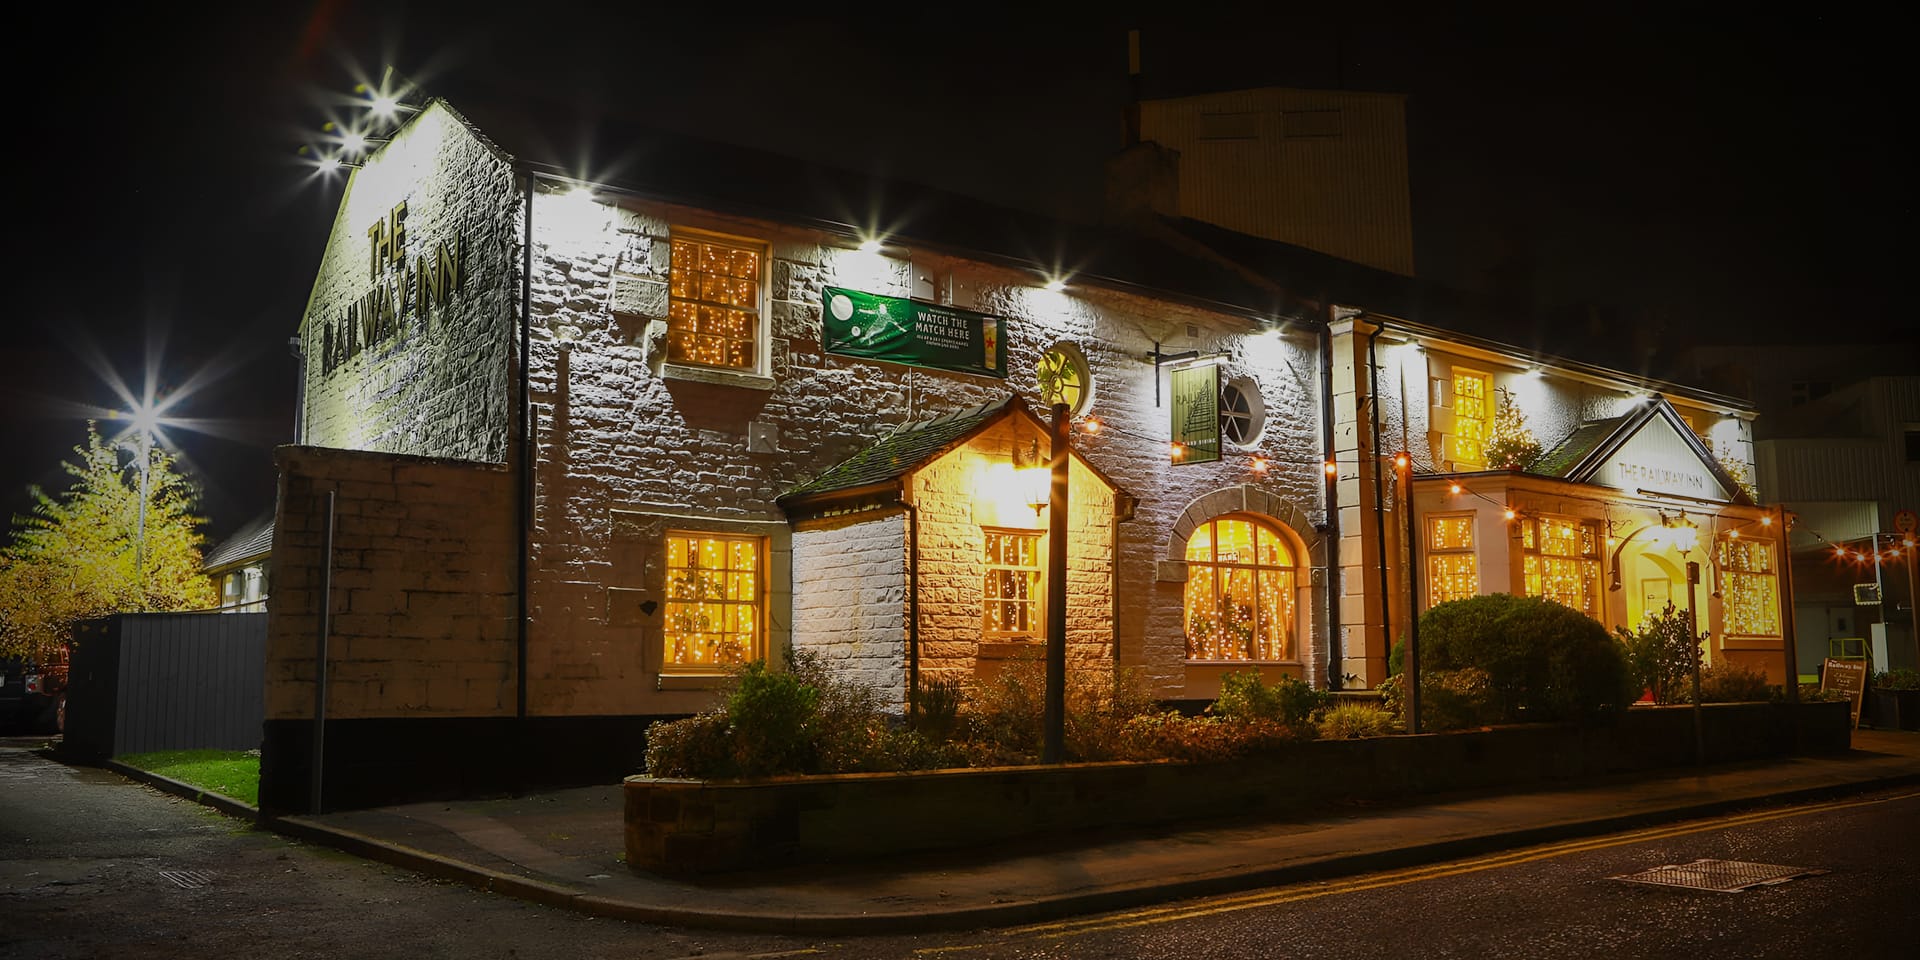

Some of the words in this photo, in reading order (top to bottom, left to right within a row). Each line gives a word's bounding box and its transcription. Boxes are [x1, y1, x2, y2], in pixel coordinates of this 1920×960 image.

[368, 200, 407, 281] THE
[322, 263, 411, 376] RAILWAY
[416, 229, 461, 318] INN
[915, 322, 945, 336] MATCH
[947, 327, 970, 340] HERE
[917, 311, 949, 326] WATCH
[951, 317, 968, 329] THE
[1618, 462, 1639, 482] THE
[1640, 466, 1684, 486] RAILWAY
[1686, 473, 1703, 489] INN
